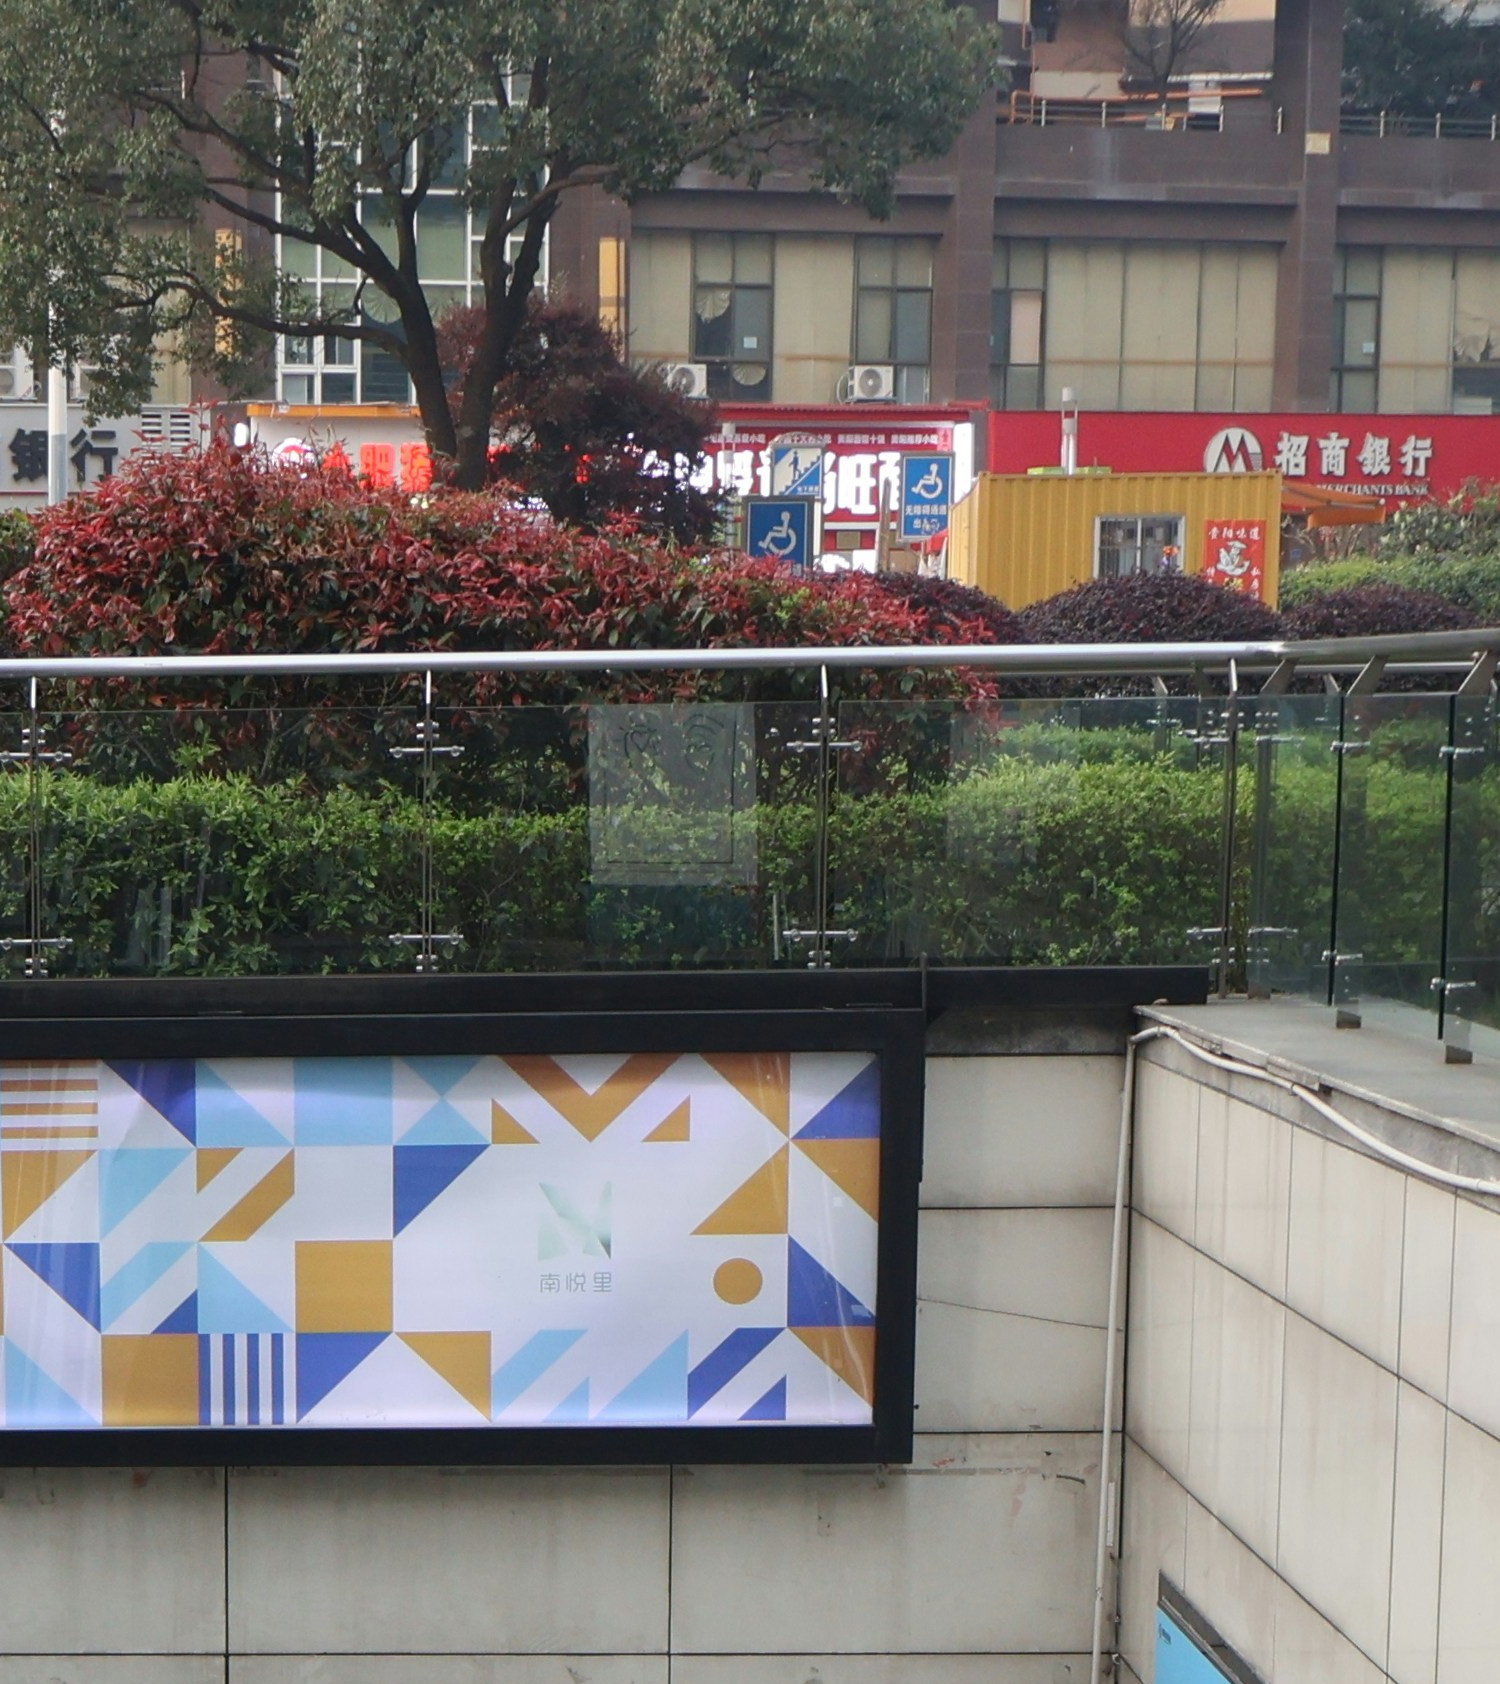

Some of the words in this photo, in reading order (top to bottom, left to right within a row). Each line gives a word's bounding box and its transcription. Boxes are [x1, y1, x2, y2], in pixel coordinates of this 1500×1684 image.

[1275, 431, 1433, 477] 招商银行
[1394, 483, 1429, 495] BANK
[905, 505, 946, 515] 无障碍通道
[540, 1272, 612, 1293] 南悦里
